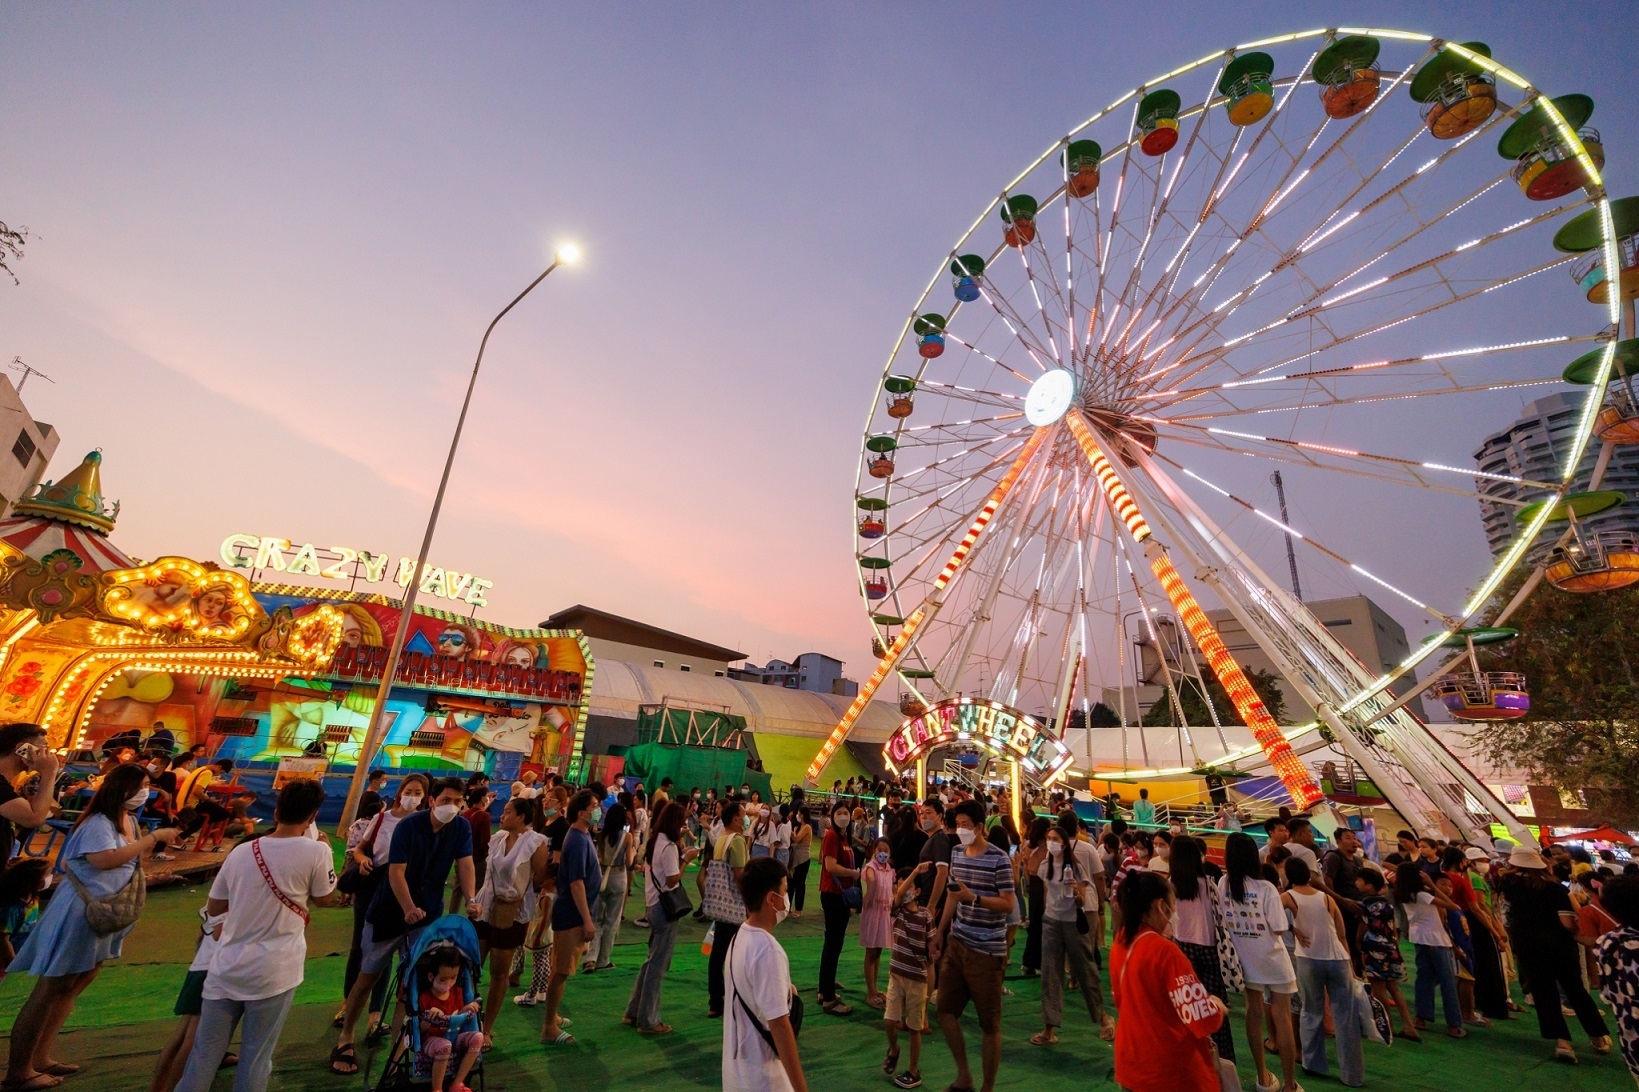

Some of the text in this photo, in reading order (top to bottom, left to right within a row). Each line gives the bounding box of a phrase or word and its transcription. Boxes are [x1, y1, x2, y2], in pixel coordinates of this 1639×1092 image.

[219, 533, 494, 607] CRAZY WAVE
[891, 704, 1049, 772] GIANT WHEEL
[1175, 973, 1196, 986] 1990
[1176, 997, 1219, 1025] LOVEL
